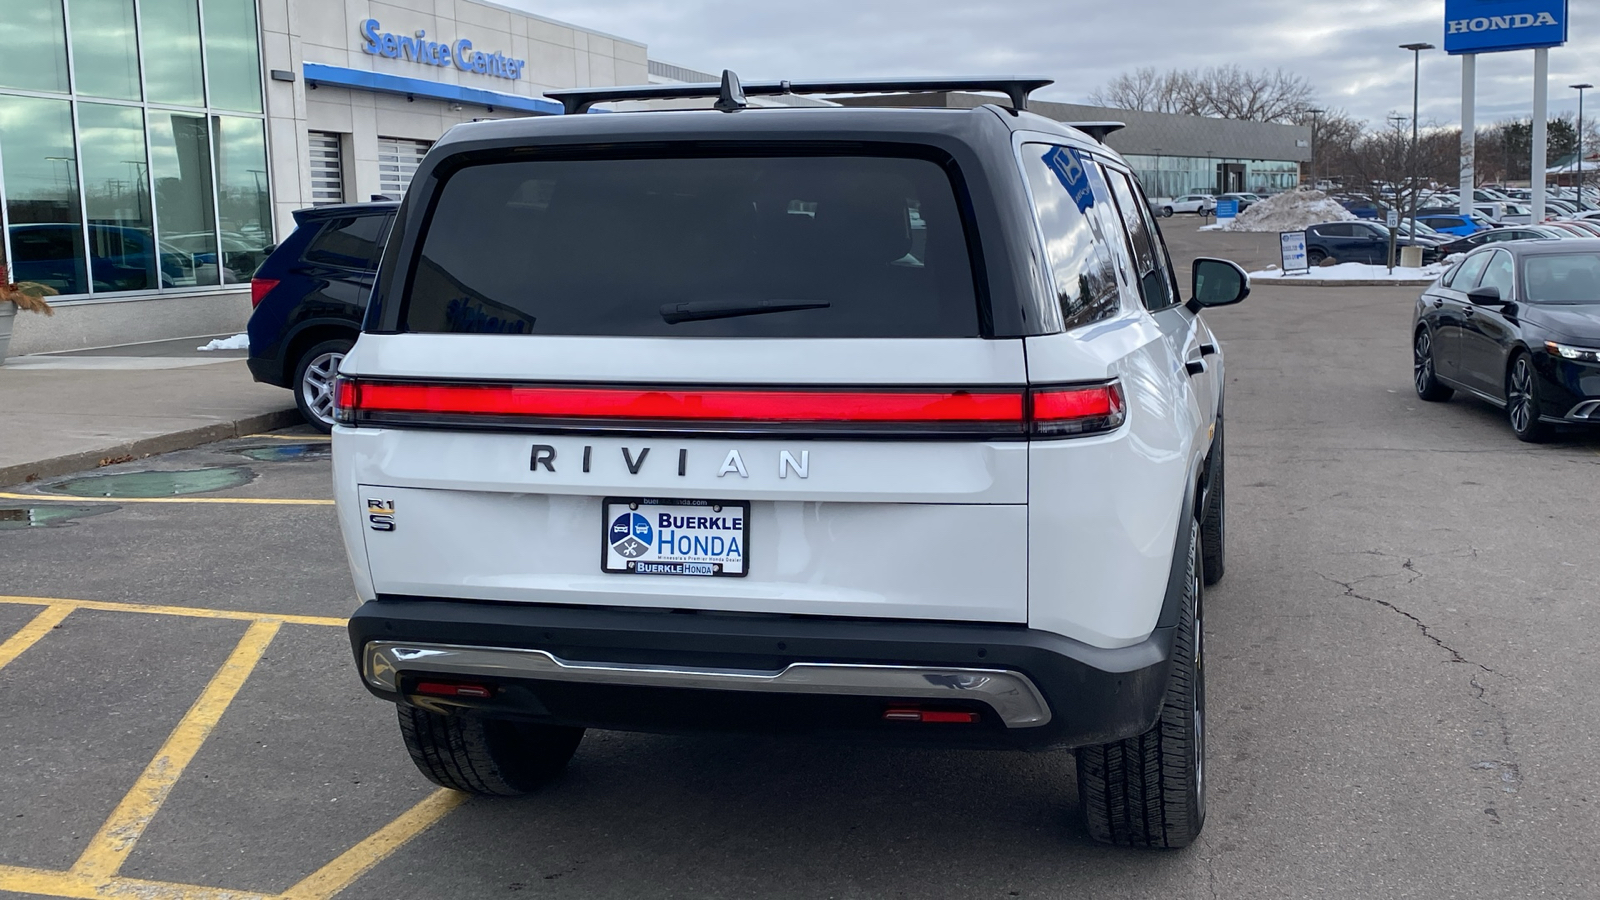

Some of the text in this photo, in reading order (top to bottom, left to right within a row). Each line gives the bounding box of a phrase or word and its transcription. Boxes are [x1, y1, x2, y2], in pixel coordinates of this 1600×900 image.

[1447, 11, 1558, 34] HONDA
[360, 18, 525, 80] Service Center
[529, 444, 809, 478] RIVIAN
[367, 497, 395, 509] R1
[369, 513, 396, 532] S
[658, 513, 742, 530] BUERKLE
[657, 530, 742, 557] HONDA
[637, 562, 712, 574] BUERKLE HONDA
